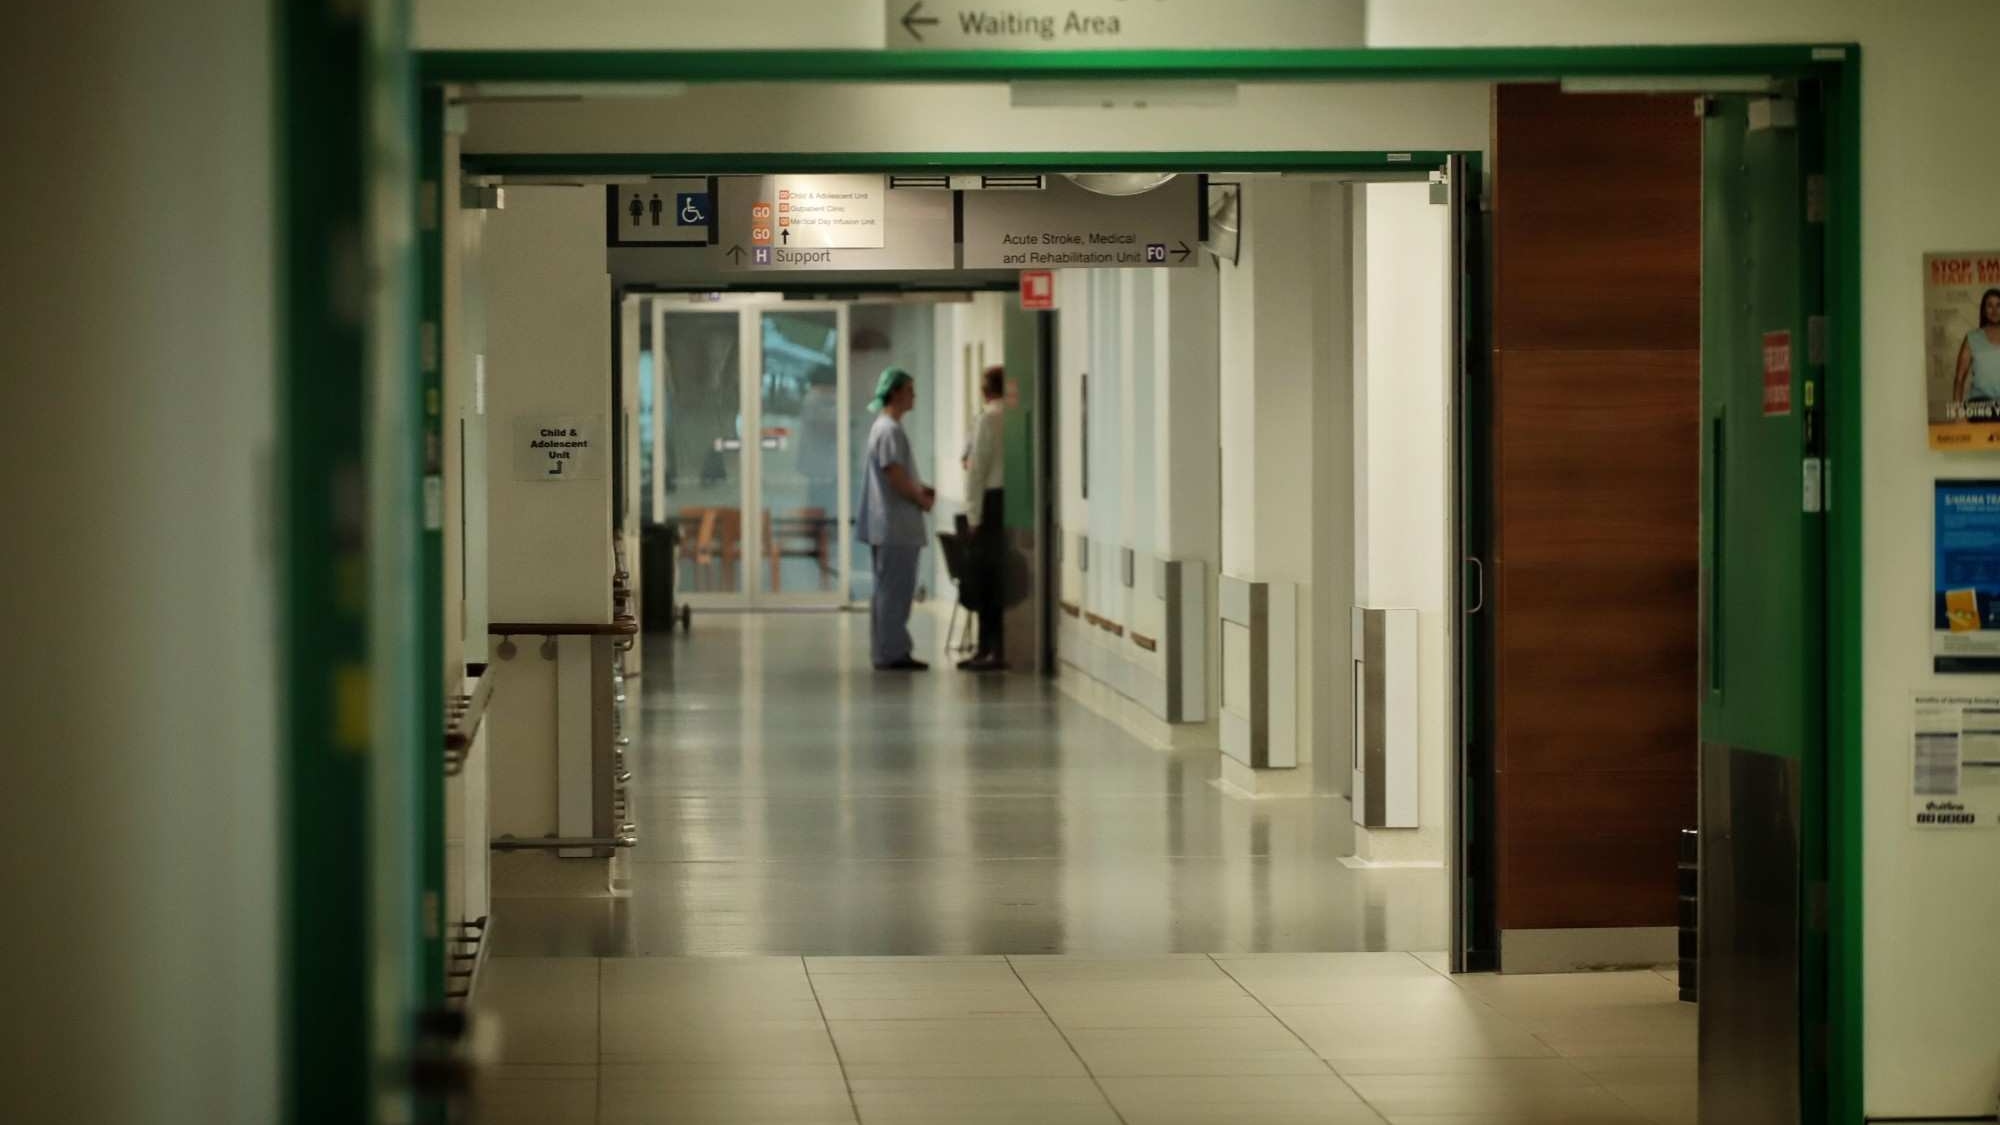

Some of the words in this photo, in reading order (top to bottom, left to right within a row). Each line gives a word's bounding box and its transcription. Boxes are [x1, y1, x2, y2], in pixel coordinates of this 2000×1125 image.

[957, 9, 1055, 40] Waiting
[1063, 9, 1121, 35] Area
[1002, 233, 1038, 245] Acute
[1088, 232, 1137, 245] Medical
[756, 249, 768, 263] H
[776, 249, 831, 265] Support
[1003, 252, 1026, 264] and
[1030, 251, 1113, 264] Rehabilitation
[1116, 251, 1142, 264] Unit
[1931, 258, 1971, 273] STOP
[540, 429, 567, 437] Child
[569, 429, 577, 437] &
[530, 440, 588, 449] Adolescent
[548, 451, 570, 459] Unit
